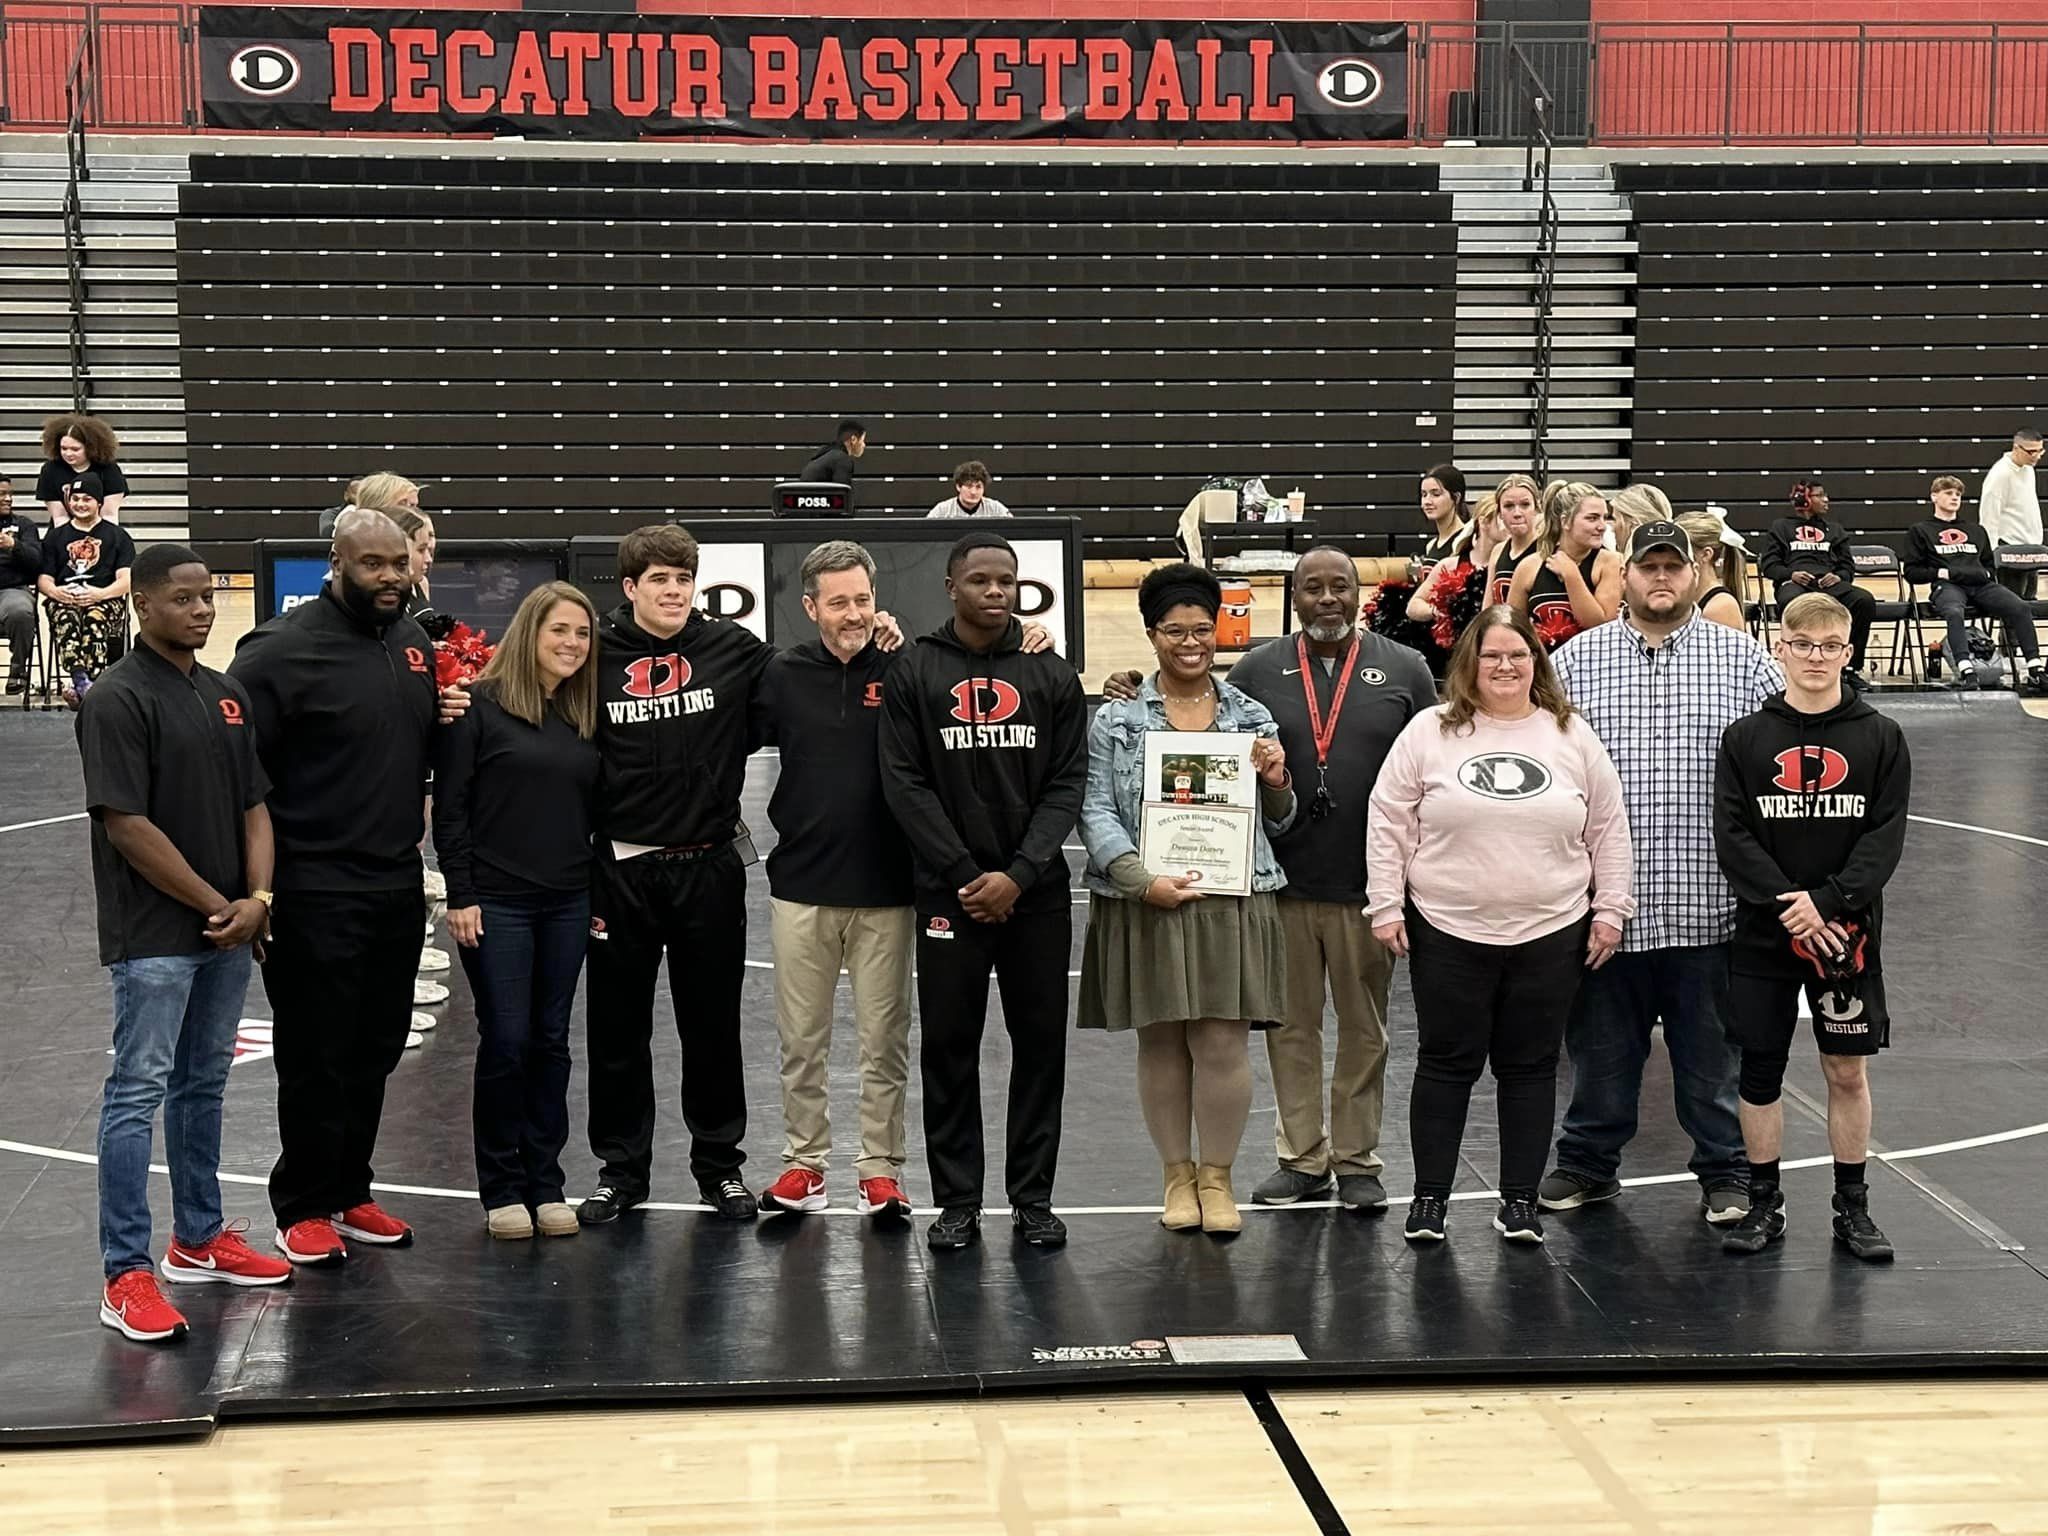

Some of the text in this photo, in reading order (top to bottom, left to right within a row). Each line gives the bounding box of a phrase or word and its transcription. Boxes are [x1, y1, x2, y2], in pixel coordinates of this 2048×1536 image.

[240, 49, 294, 91] D
[328, 27, 1294, 122] DECATUR BASKETBALL
[1327, 63, 1377, 103] D
[797, 496, 831, 508] POSS.
[702, 584, 756, 620] D
[622, 652, 693, 698] D
[606, 687, 715, 724] WRESTLING
[950, 677, 1021, 724] D
[940, 724, 1036, 750] WRESTLING
[1772, 745, 1849, 793] D
[1756, 794, 1866, 819] WRESTLING
